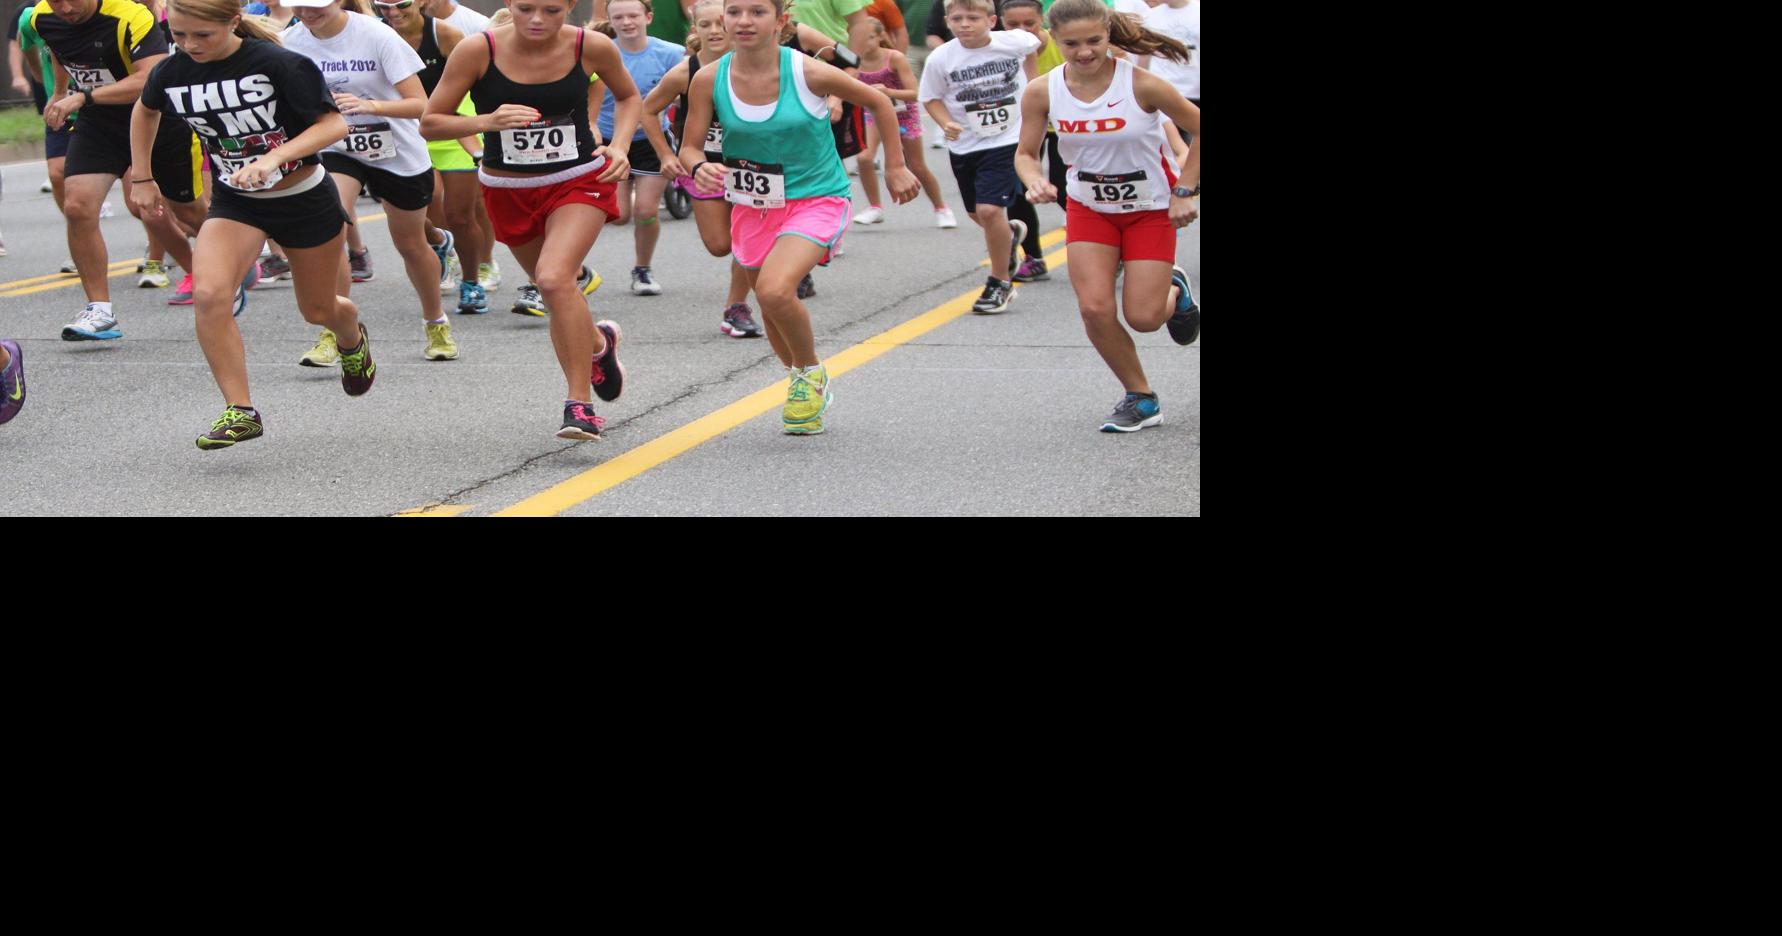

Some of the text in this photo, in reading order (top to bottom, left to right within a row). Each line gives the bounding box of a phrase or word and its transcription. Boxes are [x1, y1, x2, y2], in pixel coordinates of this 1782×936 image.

[321, 59, 377, 72] Track 2012
[949, 58, 1020, 82] BLACKHAWKS
[70, 70, 104, 84] 727
[164, 73, 275, 114] THIS
[217, 100, 277, 137] MY
[977, 108, 1010, 126] 719
[1057, 117, 1126, 134] MD
[343, 134, 383, 152] 186
[513, 128, 564, 150] 570
[732, 170, 771, 195] 193
[1091, 184, 1138, 202] 192
